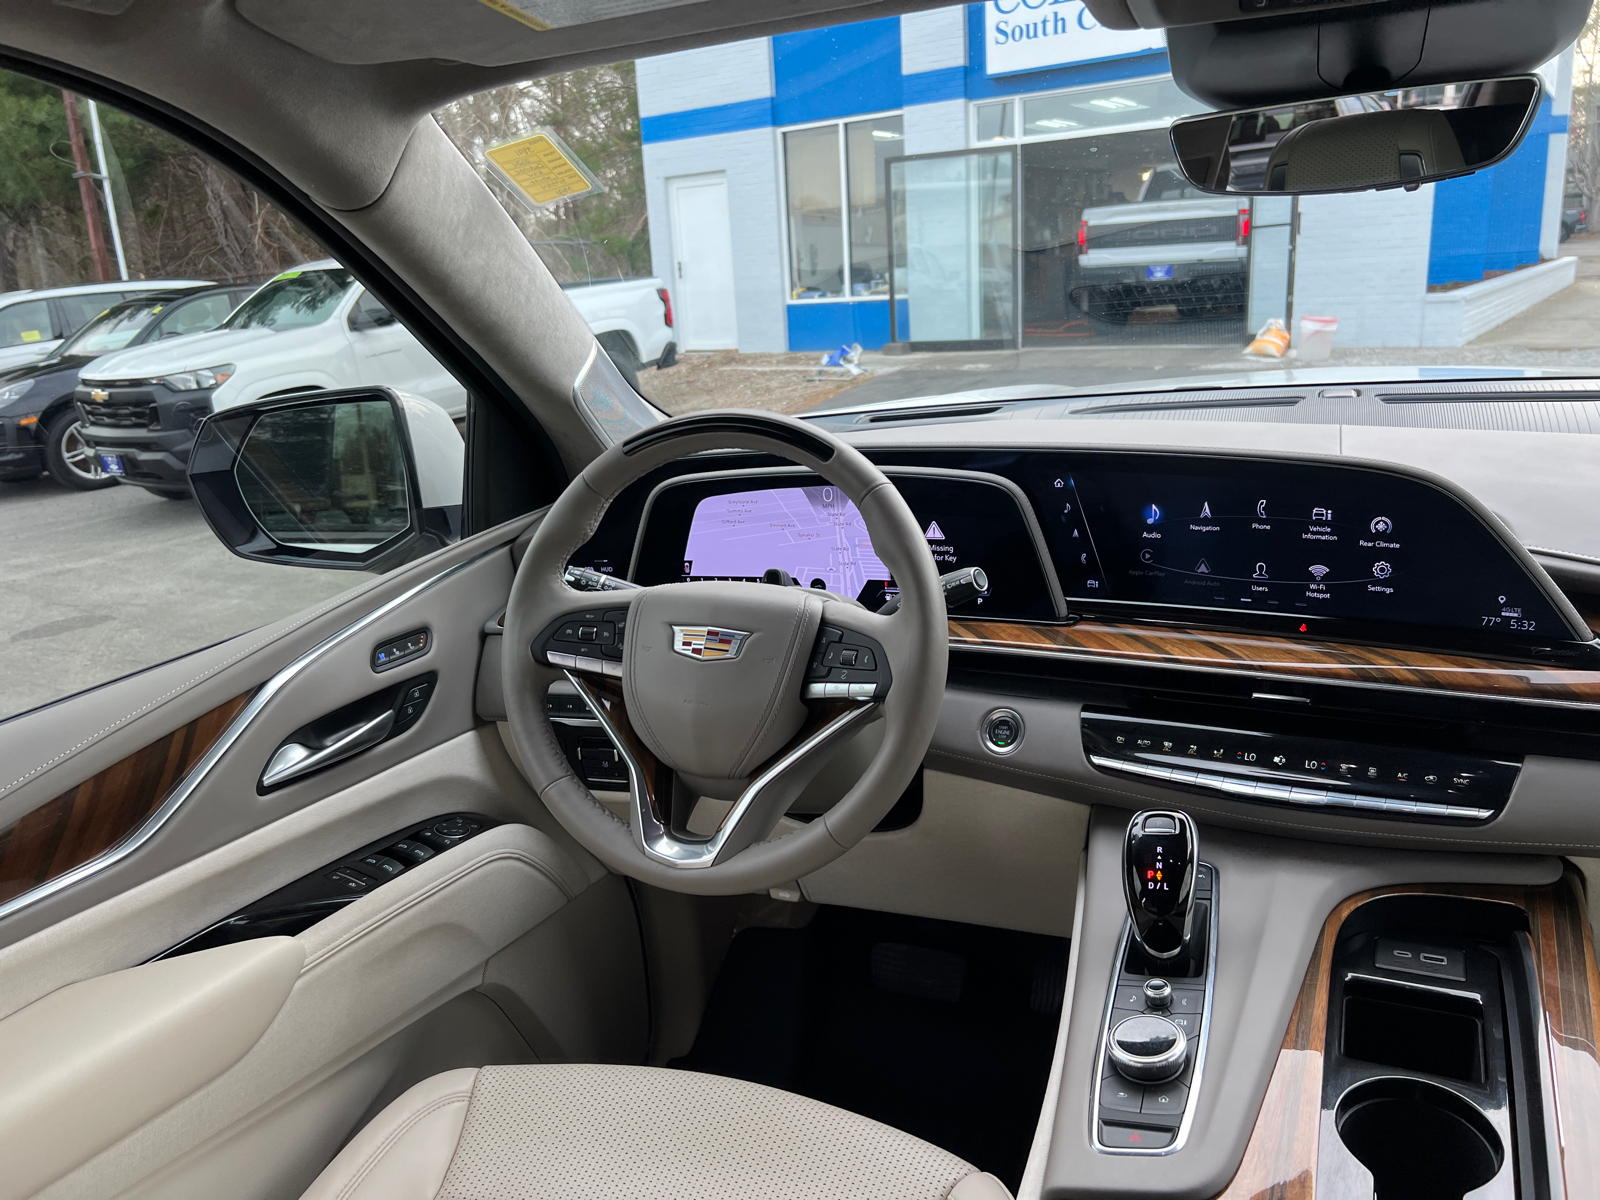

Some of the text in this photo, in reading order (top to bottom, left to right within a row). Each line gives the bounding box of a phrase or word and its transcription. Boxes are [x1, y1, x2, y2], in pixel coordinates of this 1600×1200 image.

[995, 11, 1067, 45] South
[823, 487, 833, 502] 0
[1190, 524, 1220, 532] Navigation
[1142, 531, 1161, 539] Audio
[928, 545, 954, 553] Missing
[944, 554, 957, 563] Key
[1128, 569, 1143, 577] Apple
[1309, 583, 1325, 591] Wi-Fi
[1367, 585, 1394, 594] Settings
[1305, 591, 1330, 599] Hotspot
[977, 597, 983, 605] P
[1481, 616, 1536, 631] 77° 5:32
[1244, 753, 1256, 761] LO
[1305, 760, 1318, 769] LO
[1453, 777, 1470, 785] SYNC
[1147, 870, 1154, 879] P
